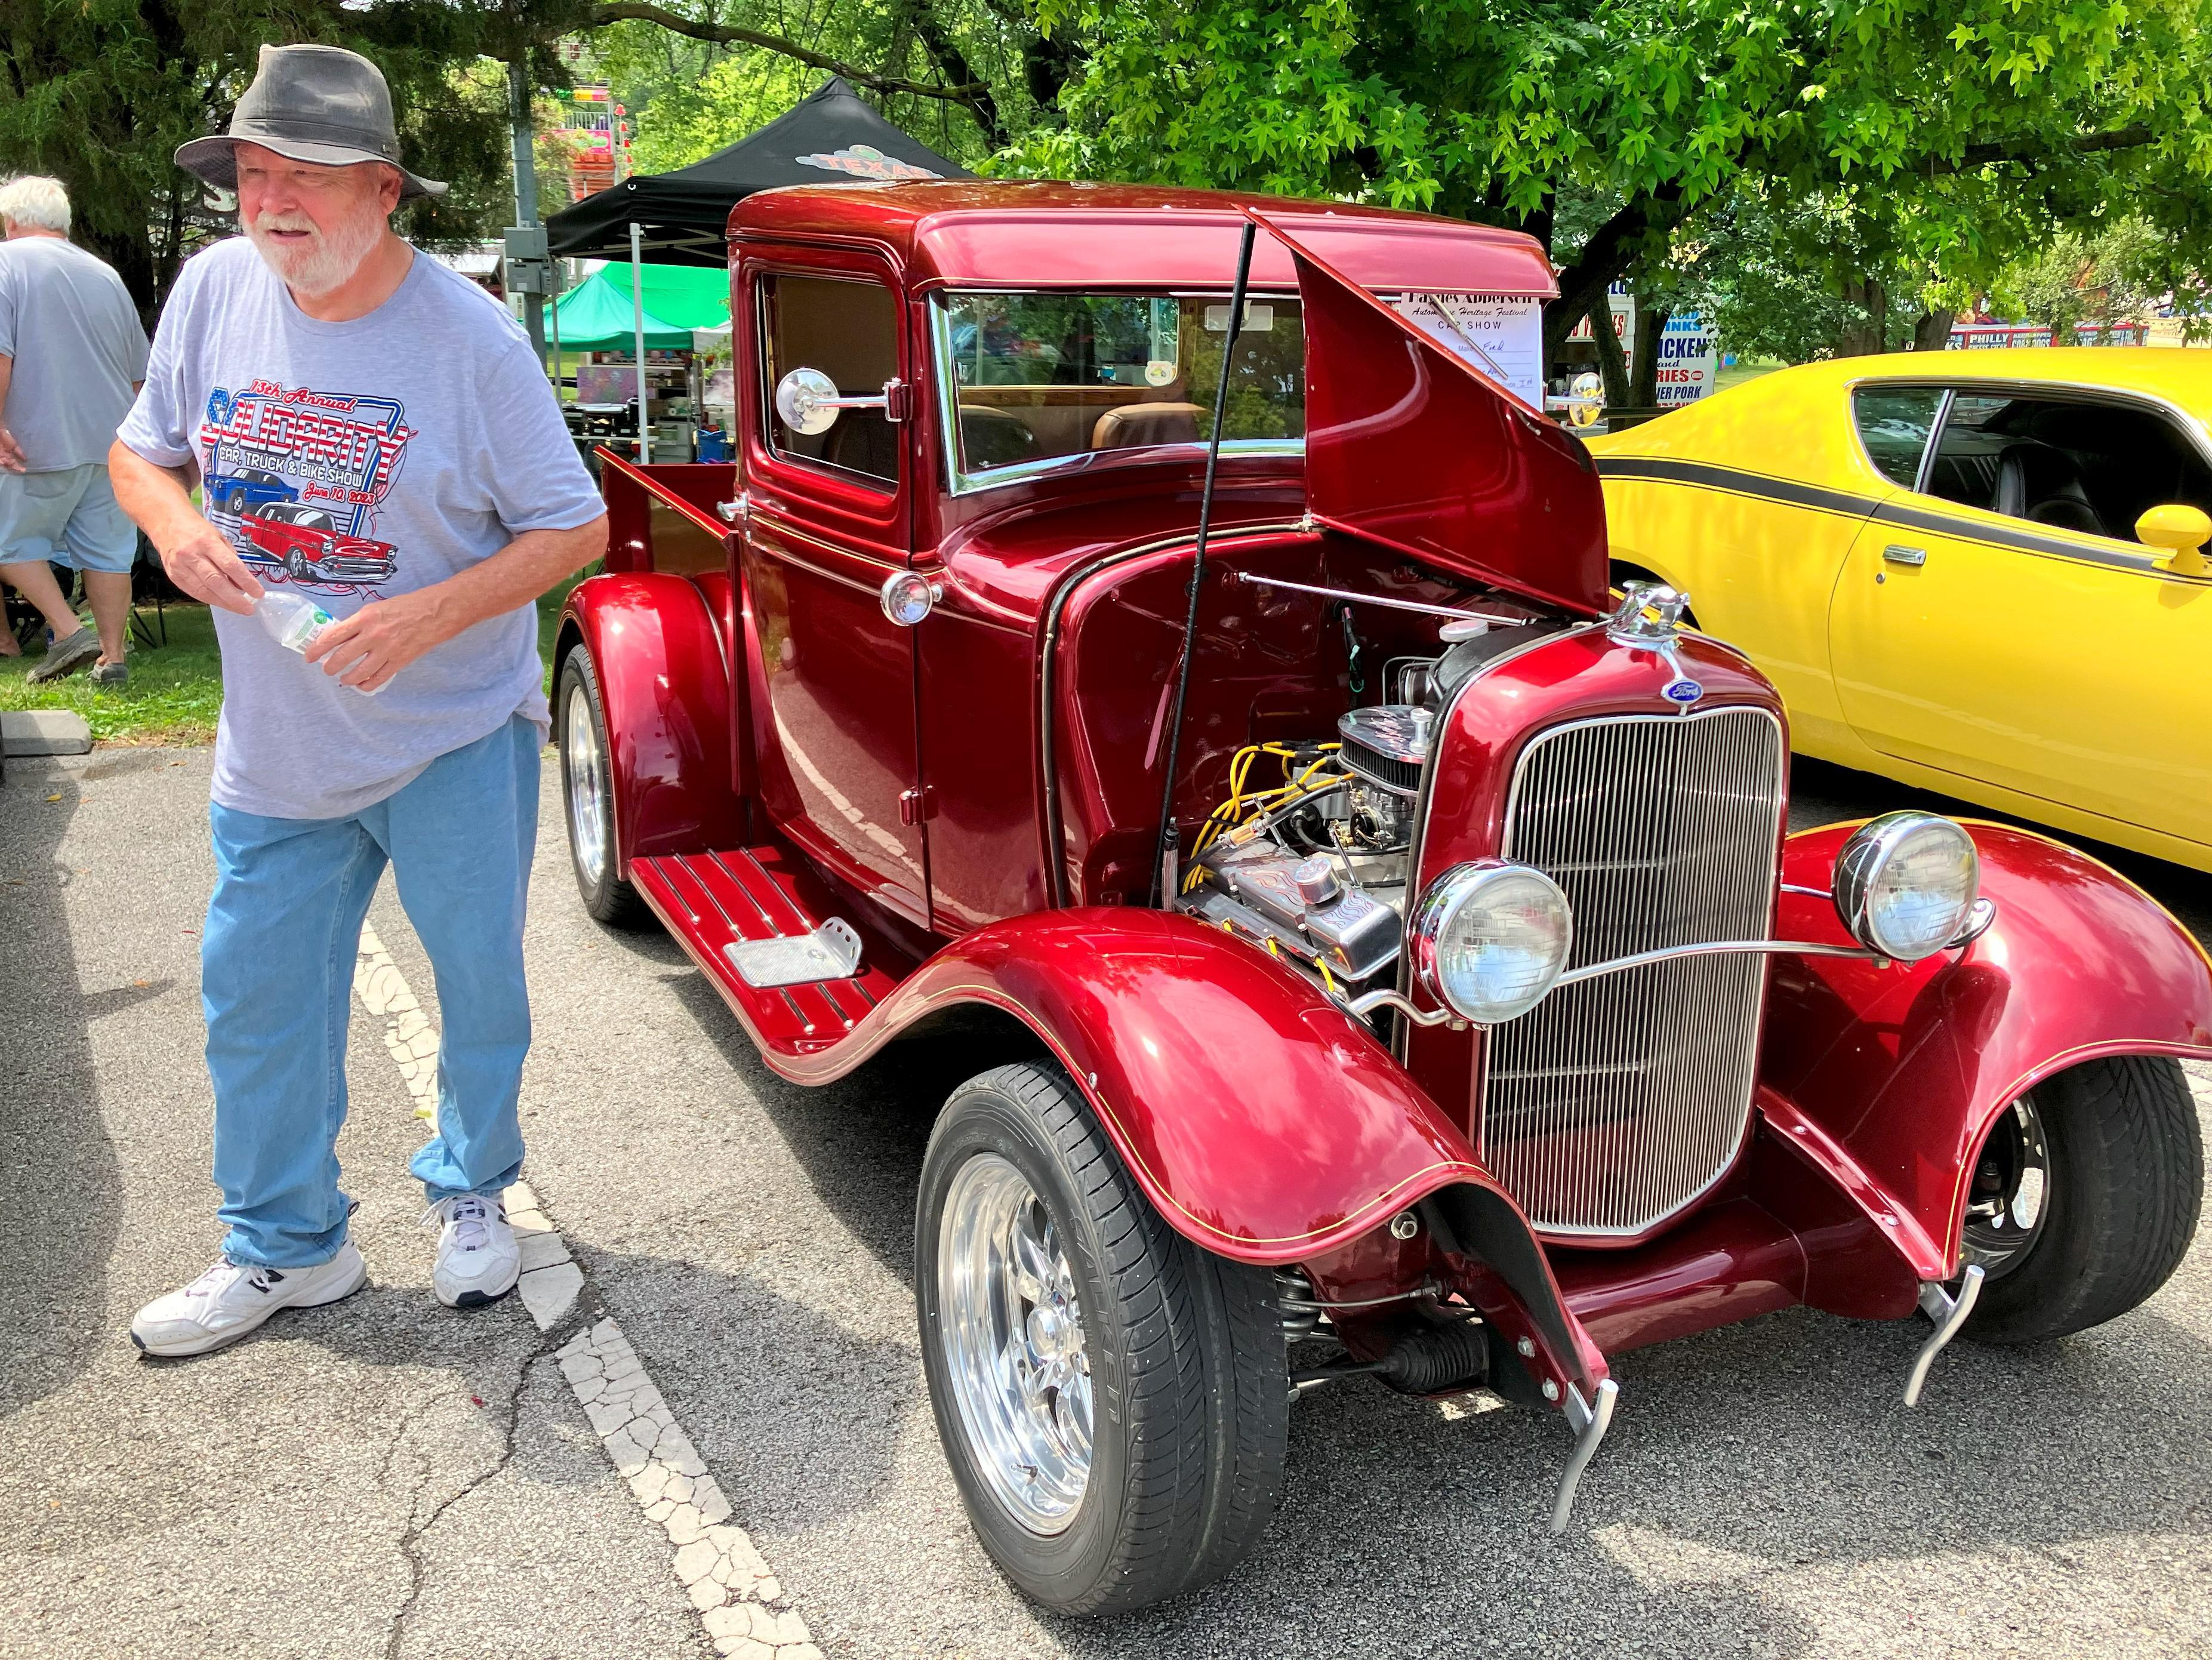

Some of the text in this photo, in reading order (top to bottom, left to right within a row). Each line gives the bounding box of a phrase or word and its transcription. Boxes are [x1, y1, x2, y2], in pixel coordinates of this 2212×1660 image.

[819, 156, 932, 179] TEXAS
[1459, 307, 1492, 318] Heritage
[1496, 307, 1528, 318] Festival
[1468, 321, 1502, 329] SHOW
[1665, 321, 1702, 331] INKS
[1970, 334, 2009, 344] PHILLY
[1658, 338, 1707, 358] ICKEN
[1656, 369, 1689, 382] RIES
[250, 379, 358, 412] 13th Annual
[1674, 386, 1702, 399] PORK
[201, 387, 409, 482] SOLIDARITY
[218, 446, 363, 488] CAR, TRUCK & BIKE SHOW
[348, 491, 376, 506] 2023
[1672, 684, 1699, 697] Ford
